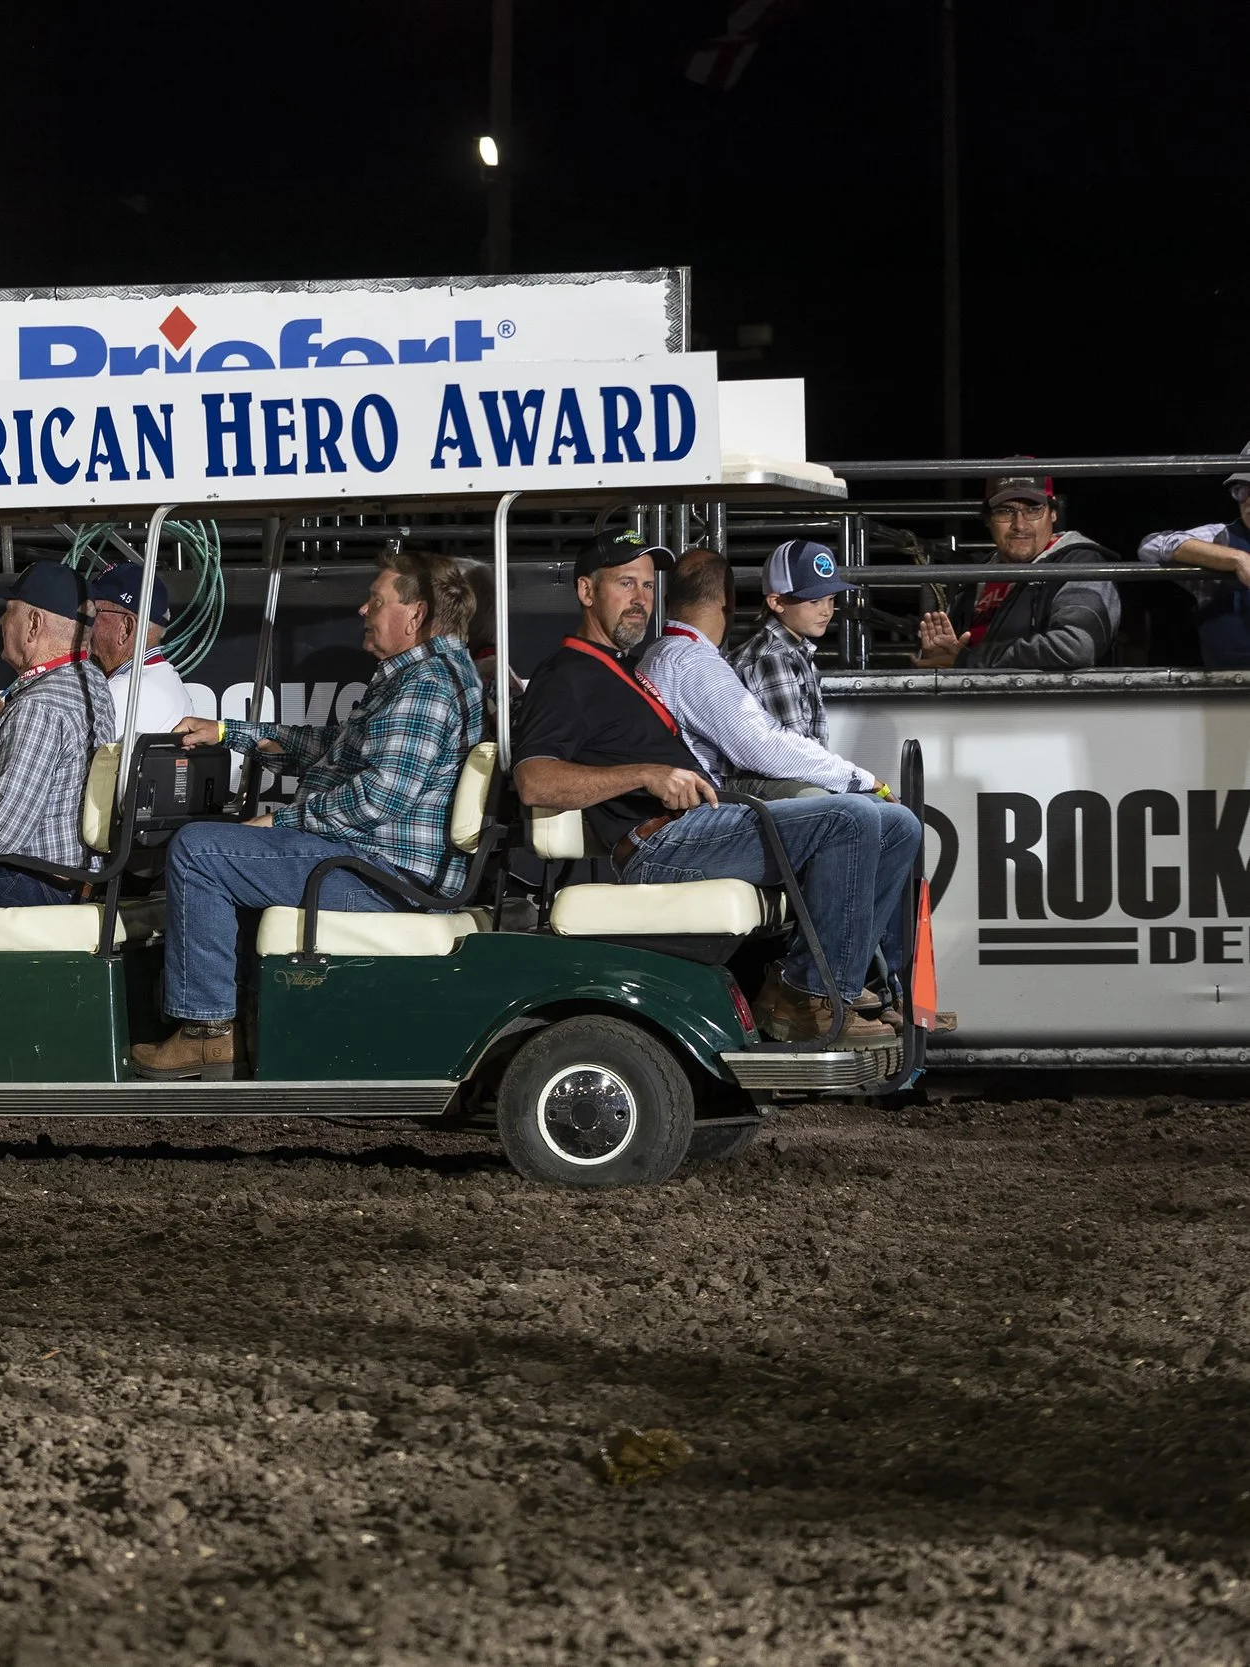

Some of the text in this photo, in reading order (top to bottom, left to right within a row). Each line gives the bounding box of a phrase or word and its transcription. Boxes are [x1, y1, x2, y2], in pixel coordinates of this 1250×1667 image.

[201, 392, 399, 478] HERO
[430, 383, 696, 470] AWARD
[120, 592, 133, 604] 45
